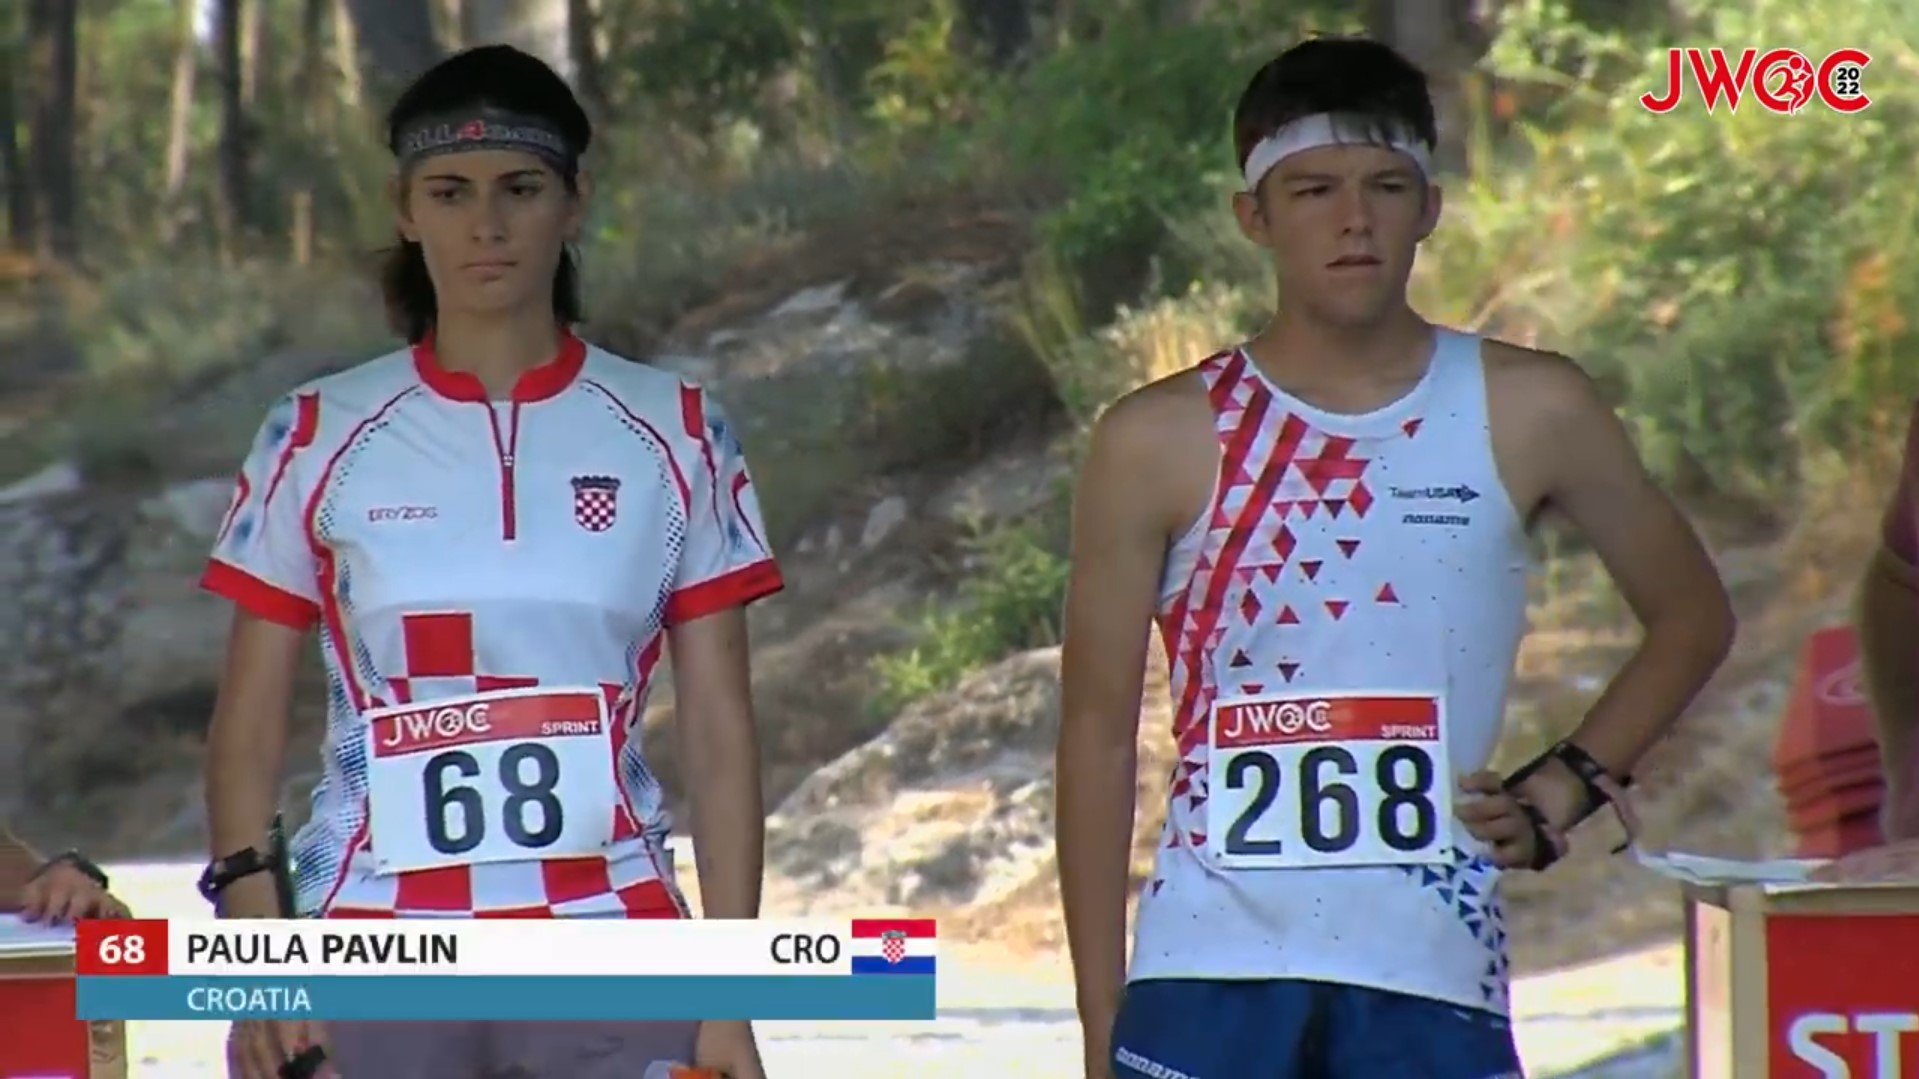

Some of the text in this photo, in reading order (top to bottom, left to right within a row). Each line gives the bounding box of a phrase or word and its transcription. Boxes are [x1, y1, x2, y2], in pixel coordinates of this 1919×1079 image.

[383, 703, 492, 747] JWOC
[541, 719, 599, 736] SPRINT
[1224, 701, 1333, 738] JWOC
[1380, 724, 1437, 739] SPRINT
[422, 742, 564, 855] 68
[1225, 744, 1437, 856] 268
